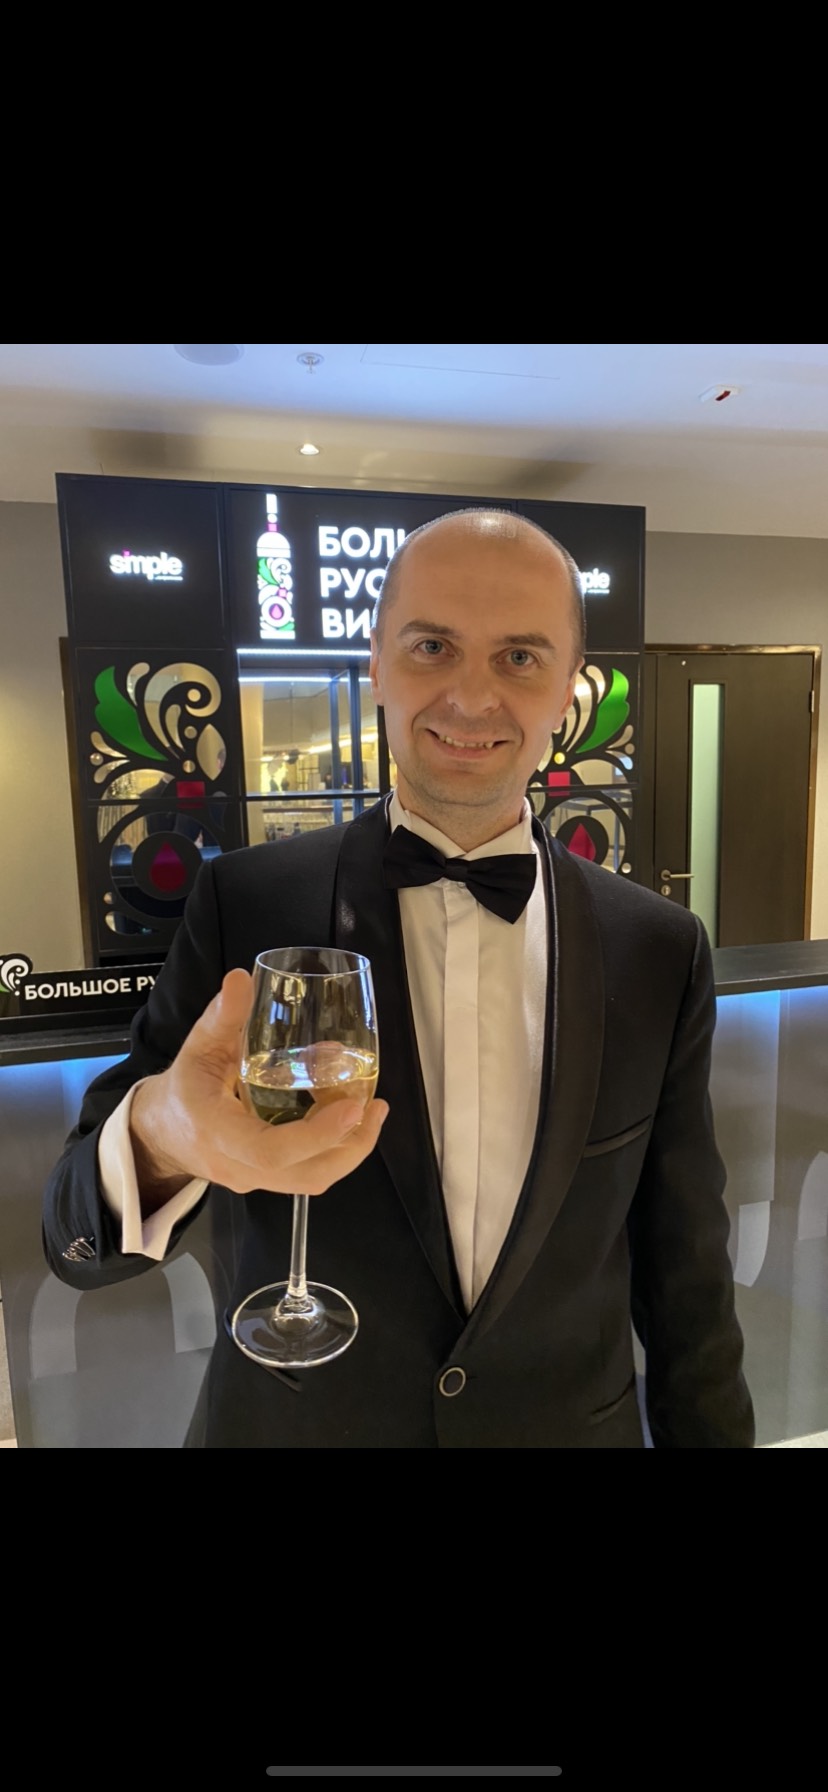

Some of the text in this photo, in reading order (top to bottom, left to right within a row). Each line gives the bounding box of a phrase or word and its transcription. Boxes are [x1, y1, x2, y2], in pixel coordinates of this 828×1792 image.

[109, 550, 183, 581] simple
[579, 567, 611, 595] ple
[24, 977, 132, 1001] БОЛЬШОЕ
